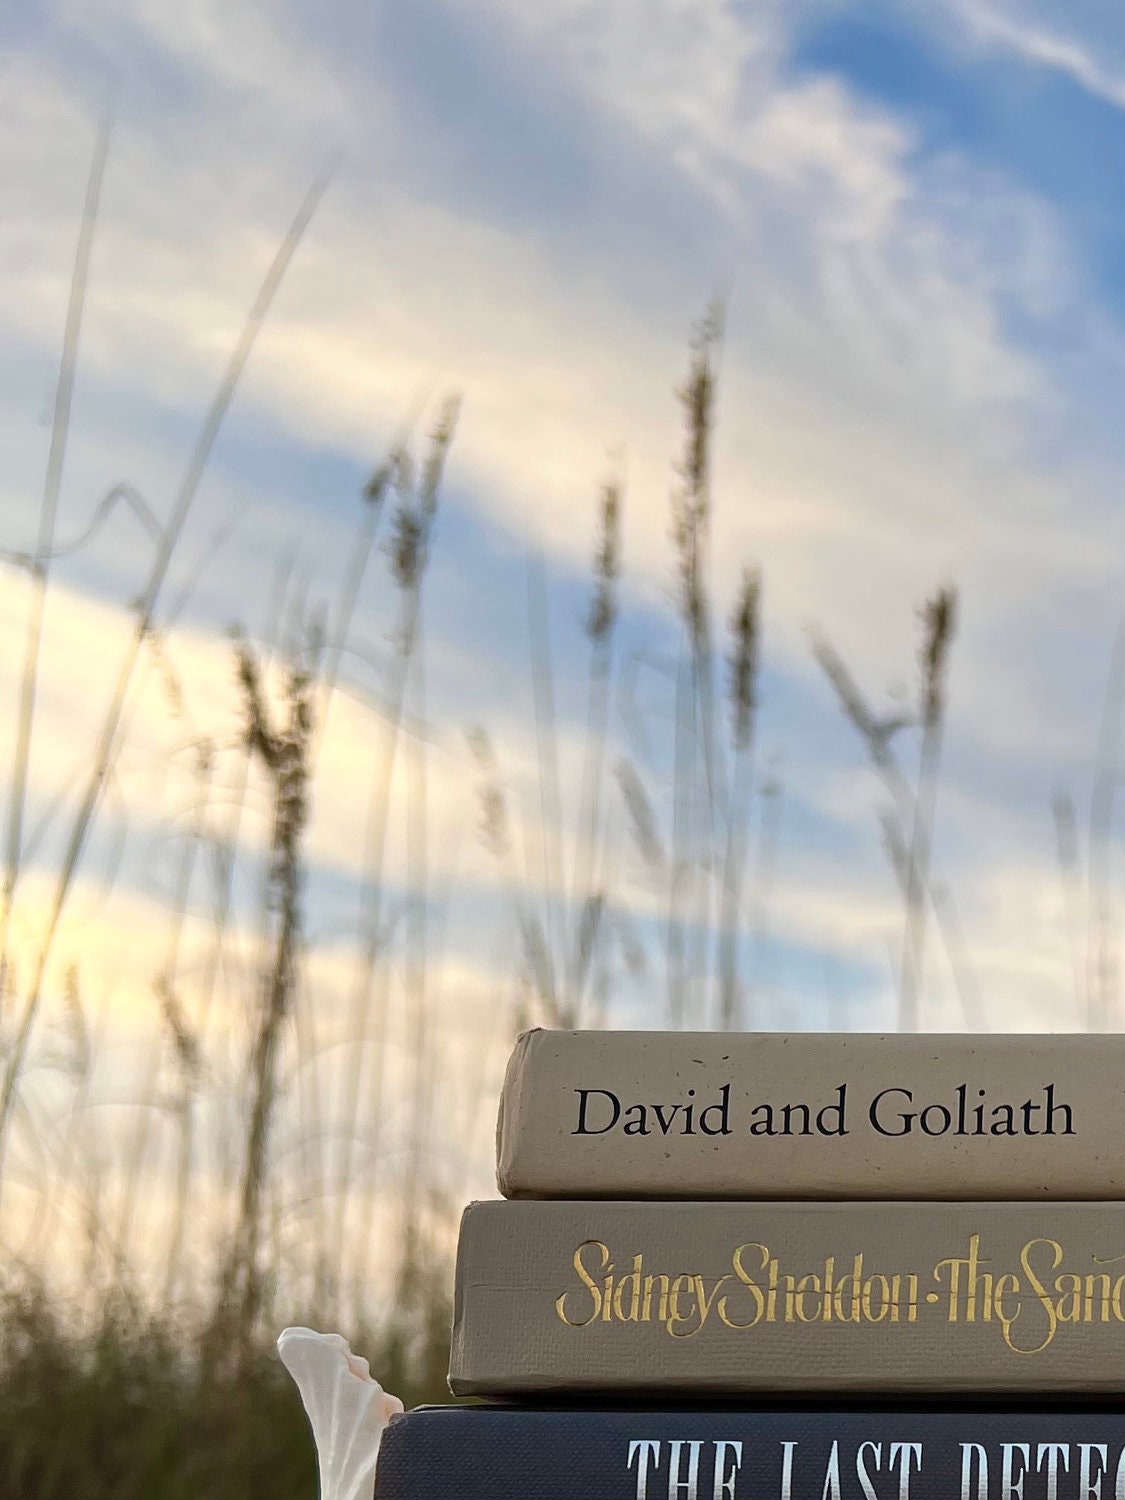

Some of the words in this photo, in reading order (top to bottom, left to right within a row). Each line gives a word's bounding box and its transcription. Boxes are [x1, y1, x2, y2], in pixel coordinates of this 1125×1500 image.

[571, 1084, 732, 1136] David
[750, 1084, 849, 1136] and
[868, 1084, 1077, 1137] Goliath
[555, 1241, 720, 1337] Sidney
[716, 1243, 918, 1328] Sheldon
